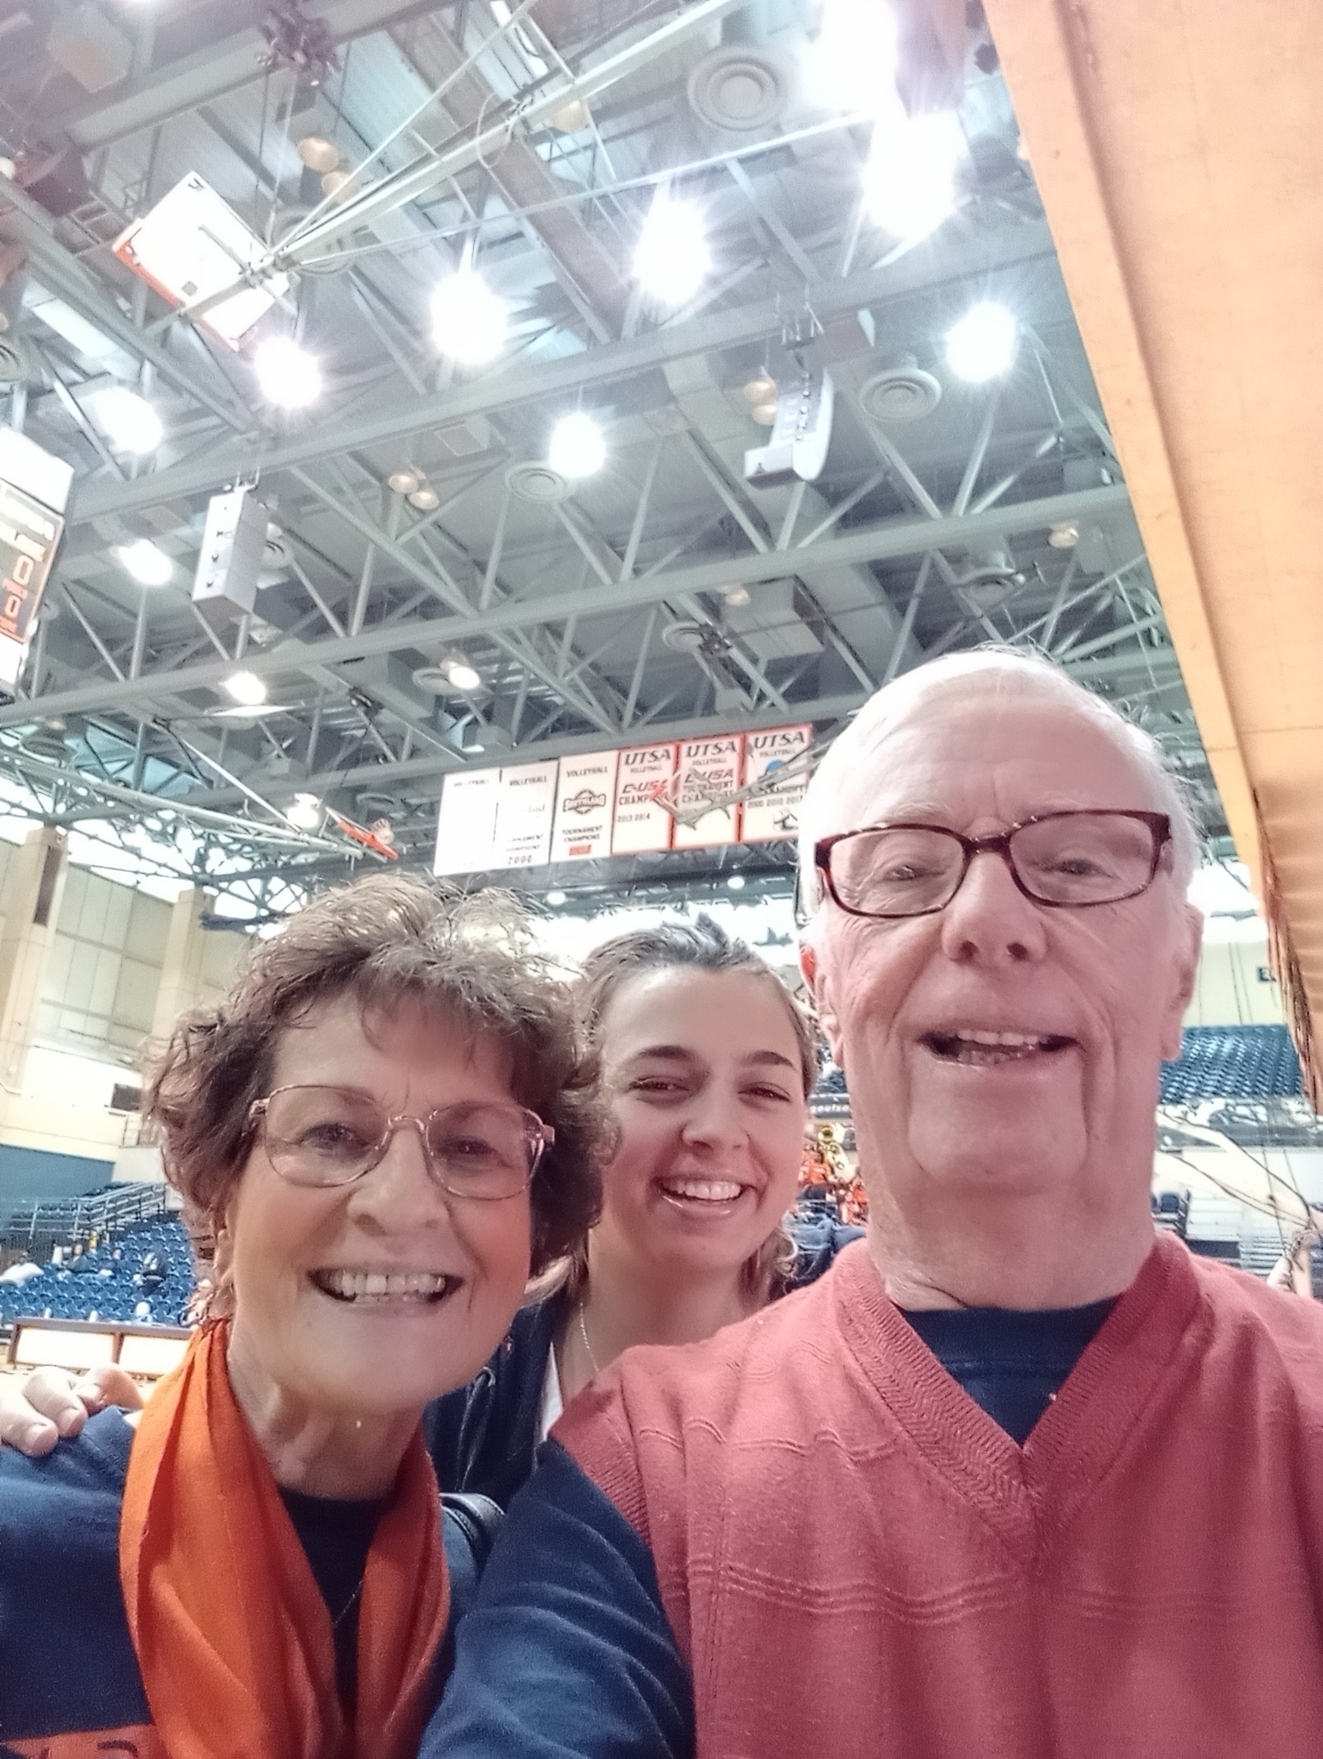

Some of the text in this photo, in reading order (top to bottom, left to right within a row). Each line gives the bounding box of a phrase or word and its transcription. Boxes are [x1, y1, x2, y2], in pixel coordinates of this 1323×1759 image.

[753, 731, 805, 749] UTSA
[686, 740, 737, 757] UTSA
[759, 748, 796, 758] VOLLEYBALL
[624, 749, 671, 766] UTSA
[692, 758, 728, 766] VOLLEYBALL
[566, 766, 608, 778] VOLLEYBALL
[630, 765, 663, 774] VOLLEYBALL
[509, 775, 548, 787] VOLLEYBALL
[562, 825, 603, 836] TOURNAMENT
[564, 833, 601, 843] CHAMPIONS
